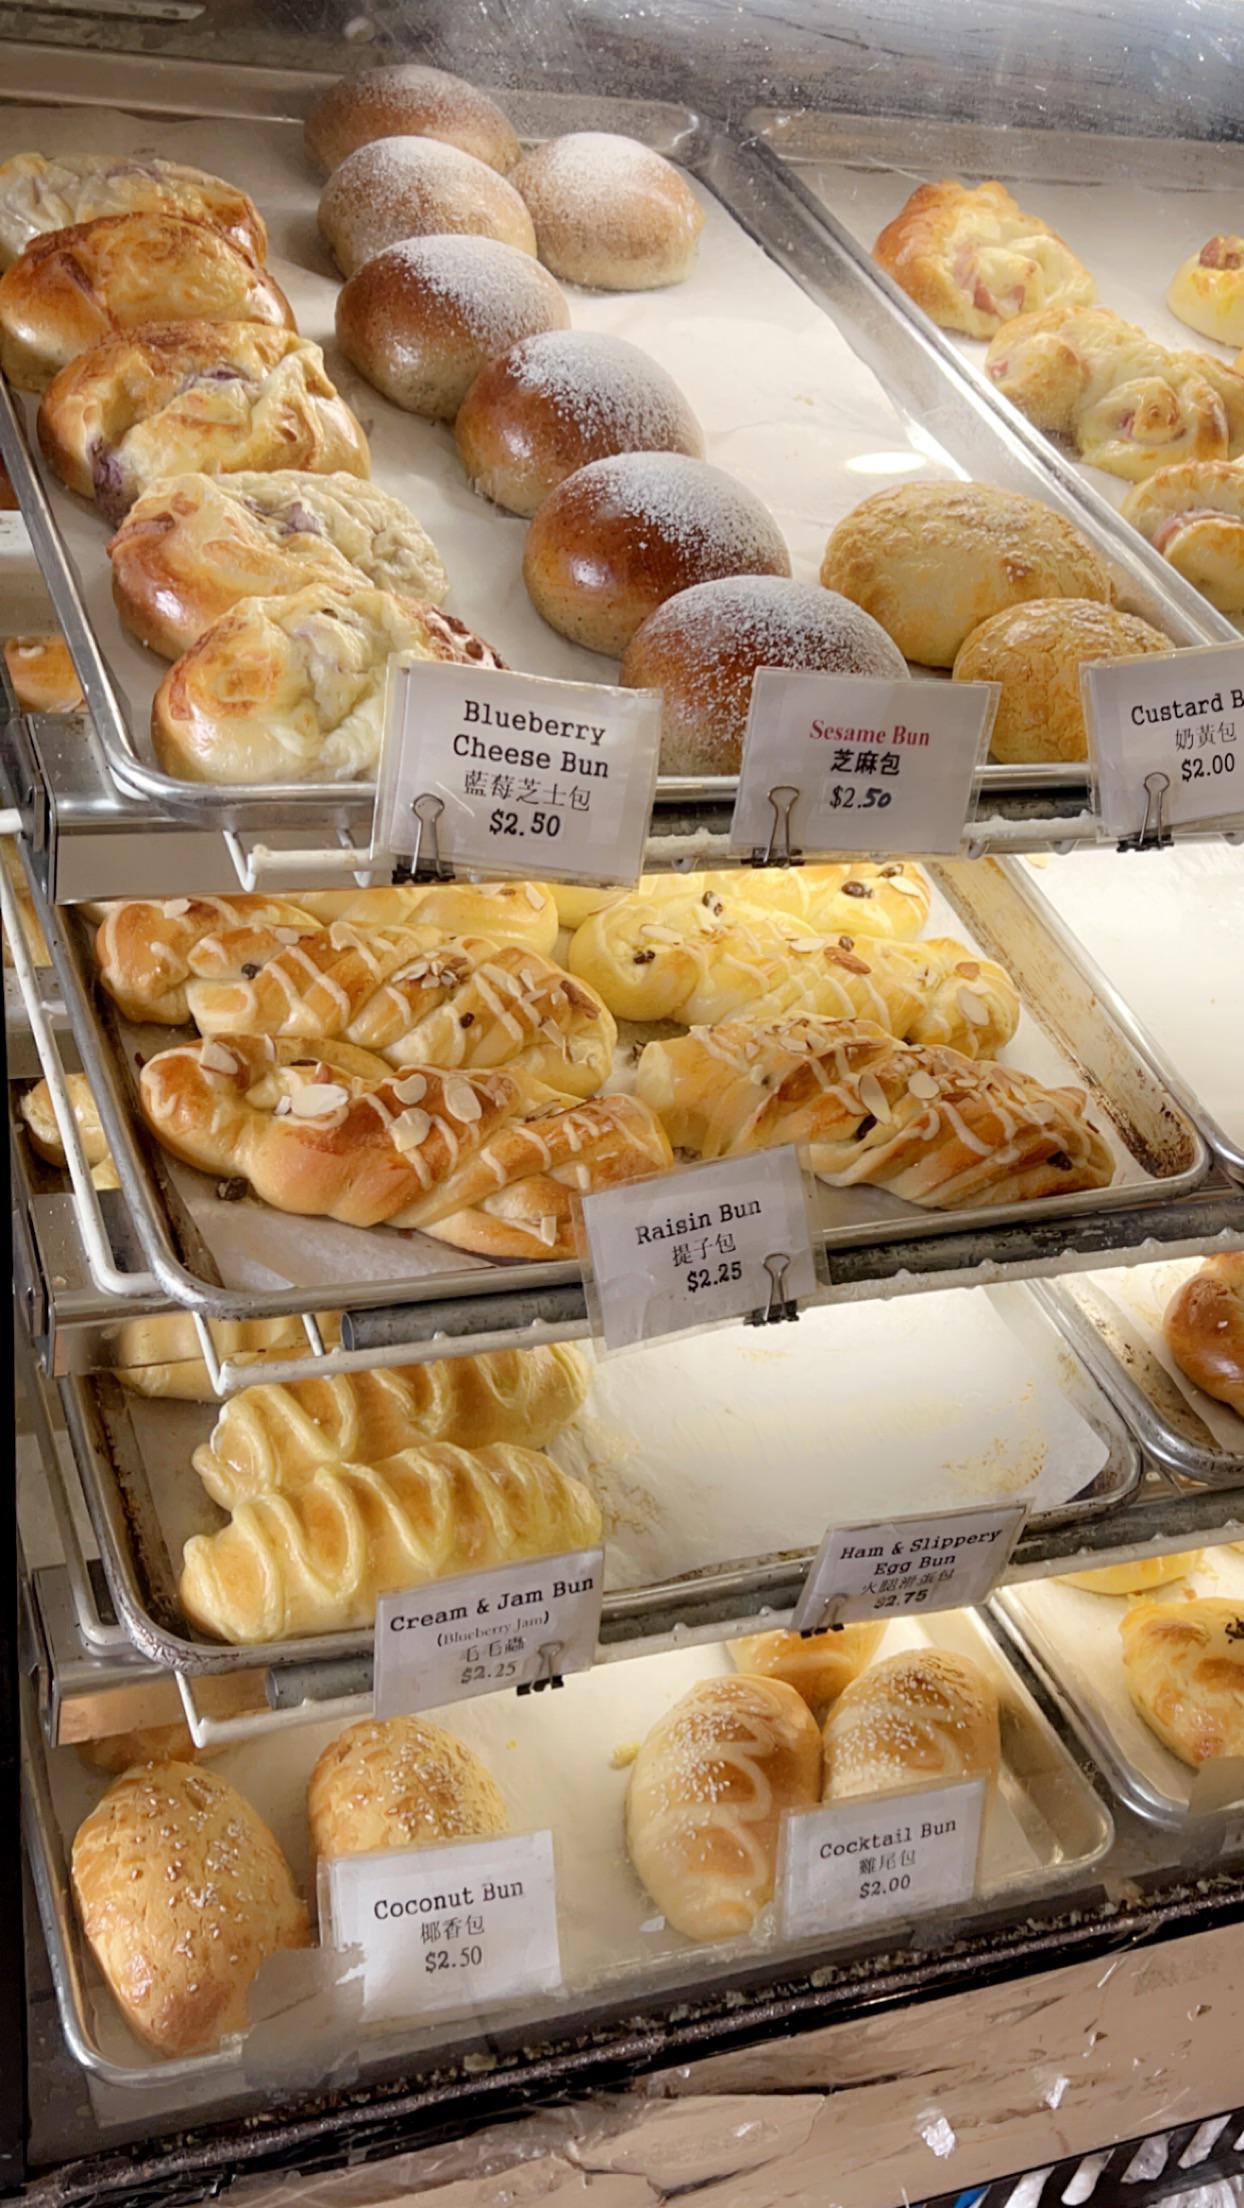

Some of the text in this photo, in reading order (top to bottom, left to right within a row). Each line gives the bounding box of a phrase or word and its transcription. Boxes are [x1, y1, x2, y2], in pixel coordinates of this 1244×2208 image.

[463, 700, 606, 746] Blueberry
[1131, 693, 1224, 726] Custard
[809, 719, 930, 746] Sesame Bun
[453, 734, 609, 778] Cheese Bun
[830, 748, 901, 776] 芝麻包
[1181, 753, 1235, 782] $2.00
[464, 770, 591, 811] 藍莓芝士包
[829, 785, 892, 809] $2.50
[489, 809, 561, 837] $2.50
[635, 1199, 762, 1245] Raisin Bun
[671, 1232, 737, 1268] 提子包
[687, 1261, 742, 1292] $2.25
[840, 1529, 1003, 1560] Ham & Slippery
[873, 1554, 956, 1577] Egg Bun
[390, 1577, 594, 1633] Cream & Jam Bun
[460, 1660, 517, 1686] $2.25
[819, 1819, 957, 1859] Cocktail Bun
[373, 1881, 524, 1921] Coconut Bun
[859, 1873, 911, 1900] $2.00
[424, 1945, 483, 1974] $2.50
